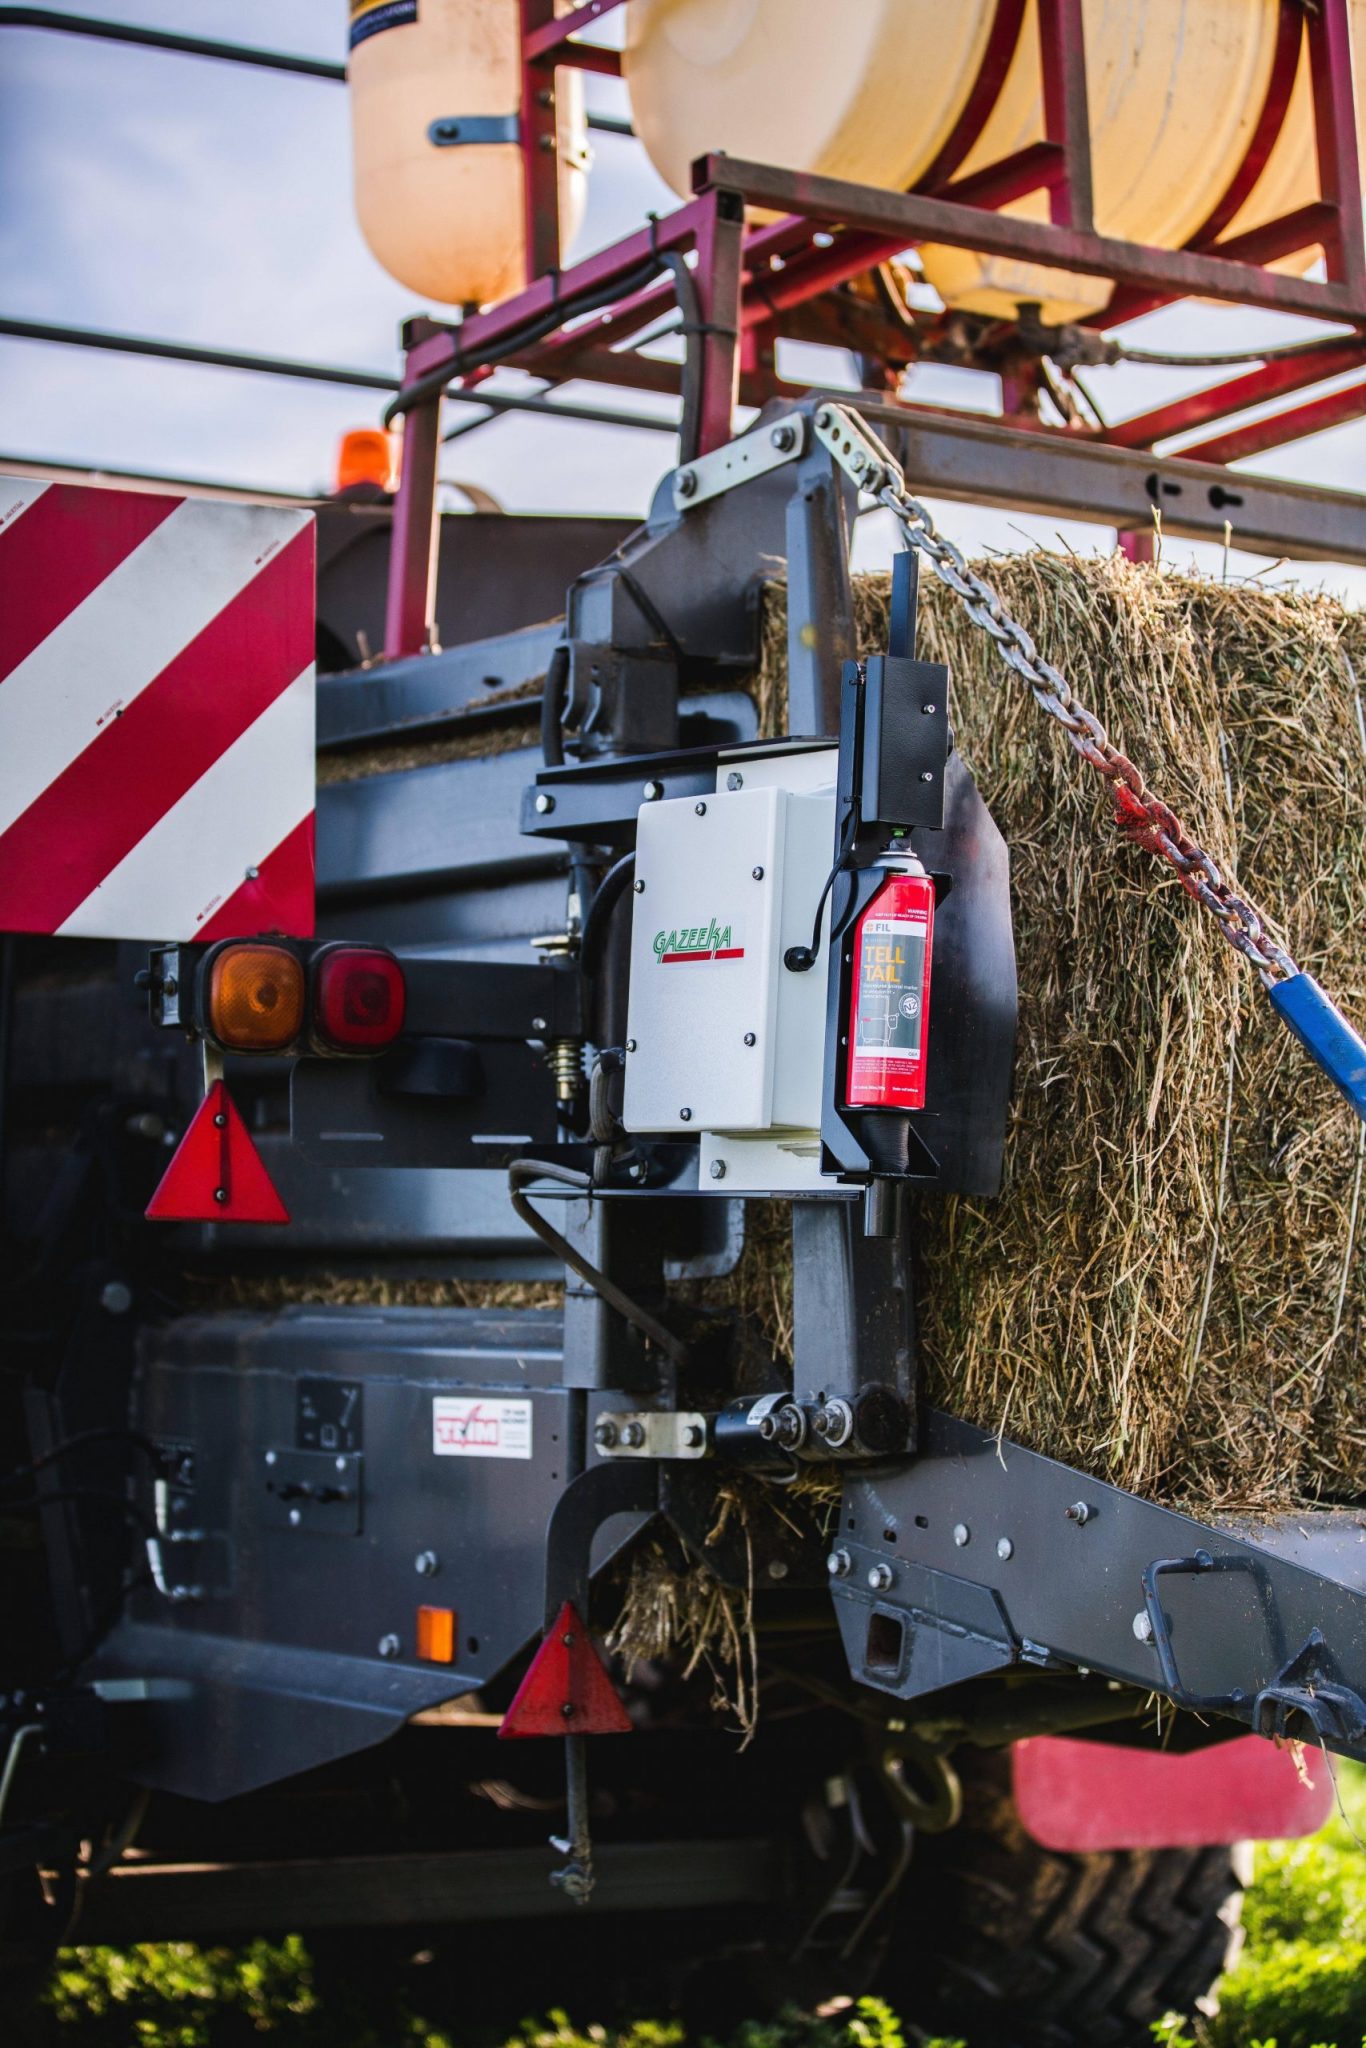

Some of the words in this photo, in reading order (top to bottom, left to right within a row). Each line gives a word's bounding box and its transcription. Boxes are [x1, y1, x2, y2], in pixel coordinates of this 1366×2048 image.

[875, 923, 891, 932] FIL
[865, 944, 906, 964] TELL
[863, 964, 901, 983] TAIL
[436, 1411, 499, 1449] TRIM
